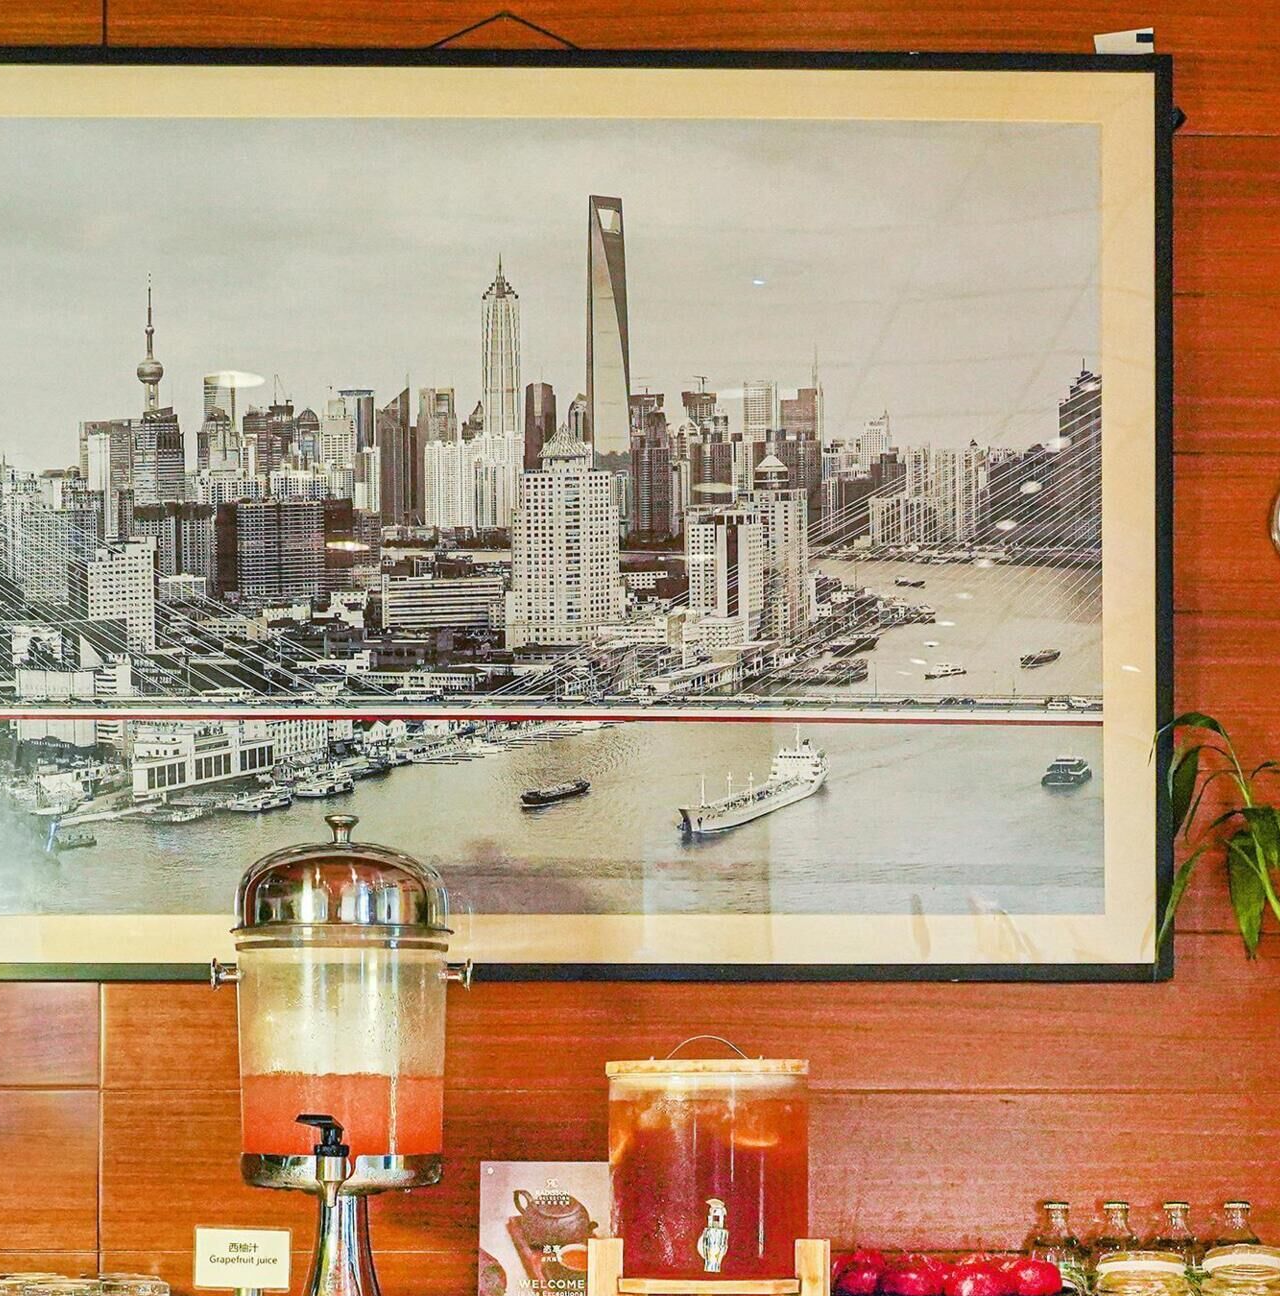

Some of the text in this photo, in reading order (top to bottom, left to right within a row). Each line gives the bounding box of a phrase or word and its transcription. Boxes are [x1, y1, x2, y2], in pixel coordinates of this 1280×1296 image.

[228, 1242, 259, 1253] 西柚汁
[209, 1254, 278, 1266] Grapefruit juice
[519, 1279, 585, 1289] WELCOME
